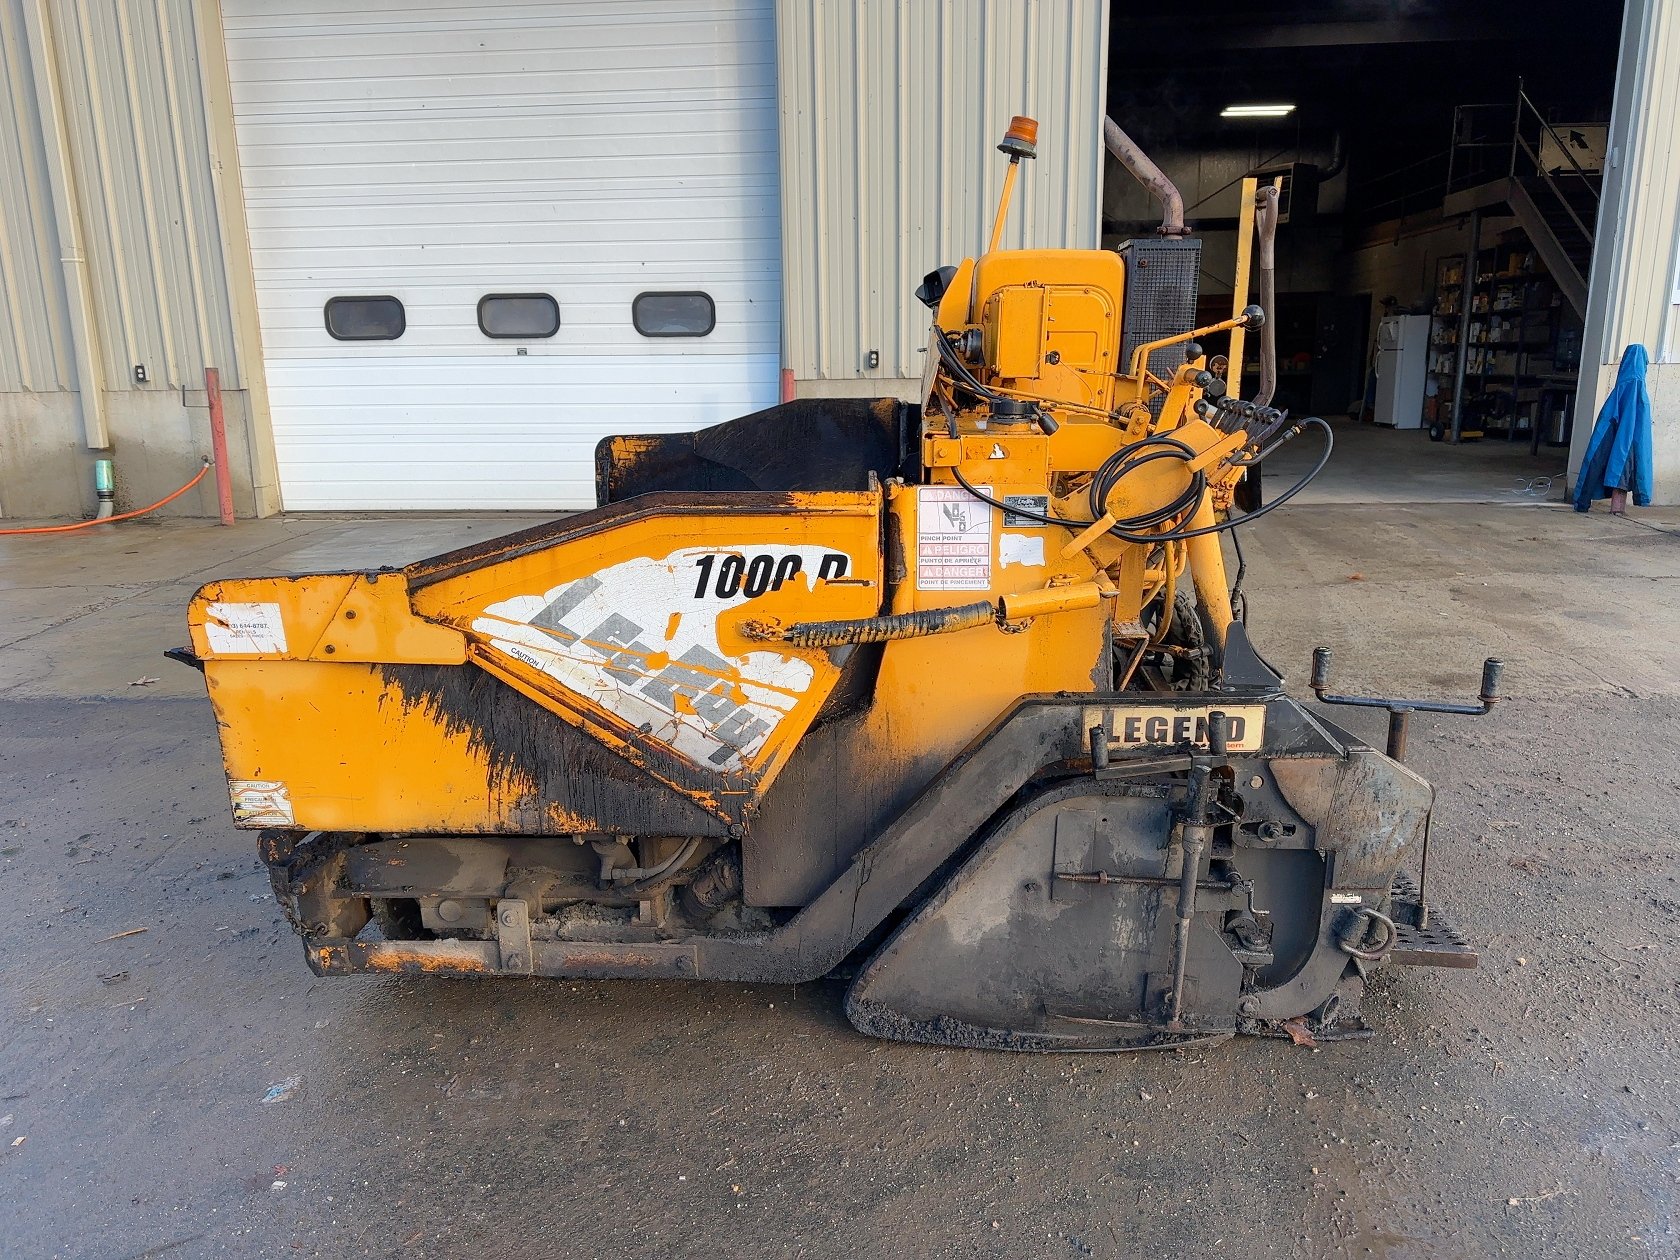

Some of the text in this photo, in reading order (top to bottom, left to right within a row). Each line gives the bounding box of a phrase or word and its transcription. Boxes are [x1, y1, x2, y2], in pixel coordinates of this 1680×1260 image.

[935, 545, 985, 554] PELIGRO
[694, 554, 802, 599] 1000
[935, 568, 983, 577] DANGER
[511, 647, 540, 667] CAUTION
